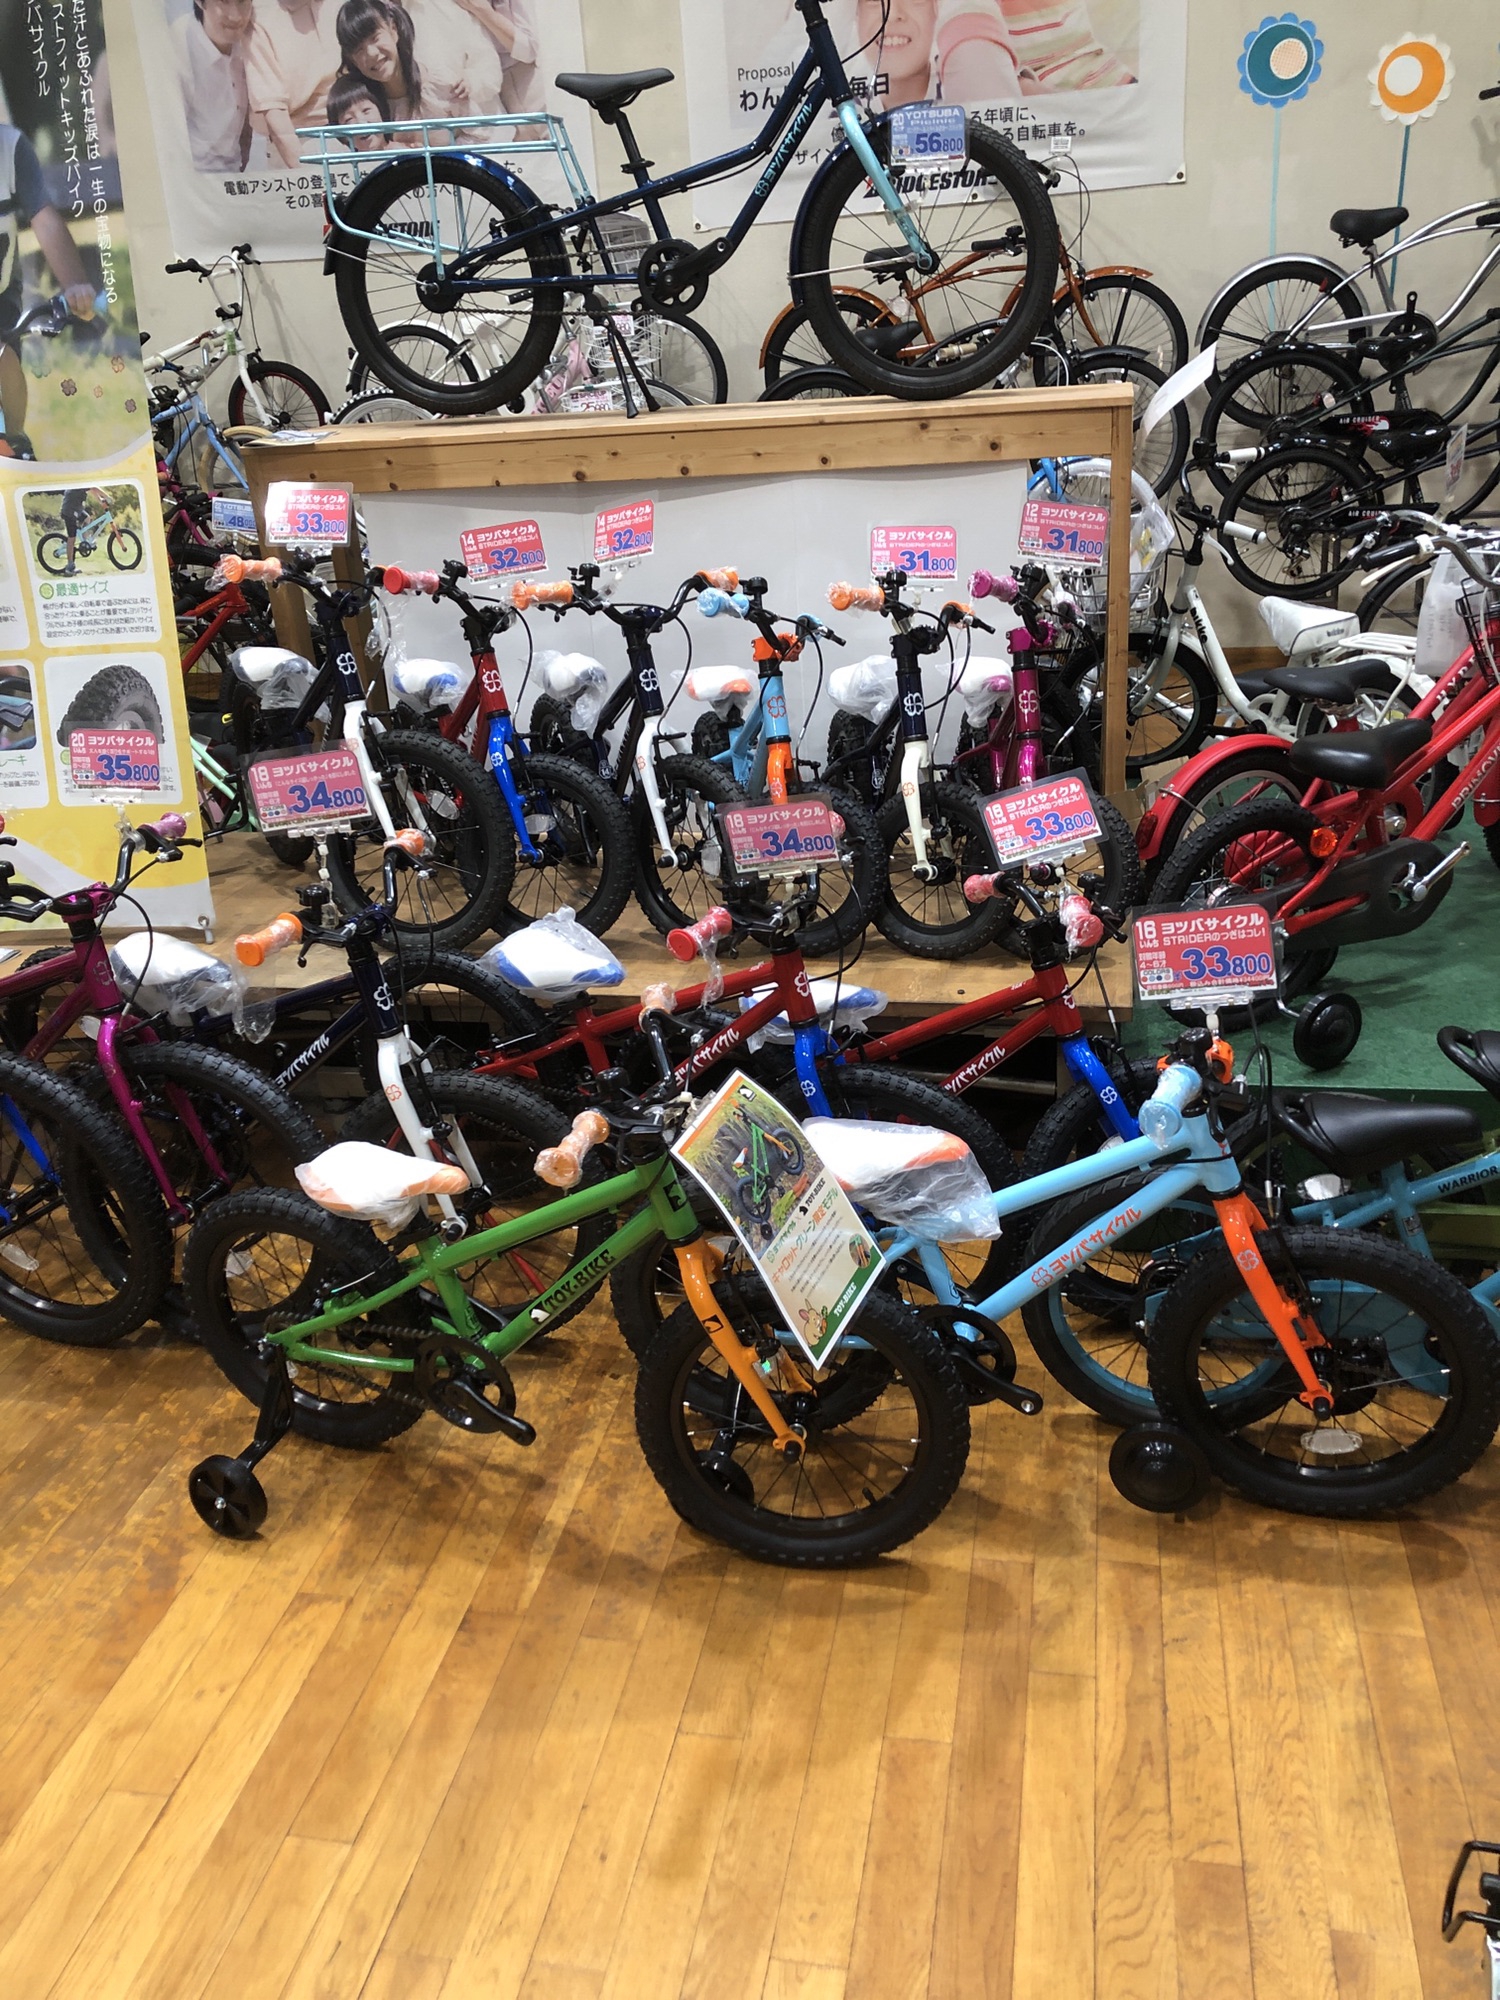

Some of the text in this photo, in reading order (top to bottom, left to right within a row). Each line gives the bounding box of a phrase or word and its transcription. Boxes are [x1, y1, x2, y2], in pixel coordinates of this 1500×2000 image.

[27, 0, 50, 97] バサイクル
[737, 61, 795, 83] Proposal
[739, 86, 790, 112] わん
[905, 108, 960, 119] YOTSUBA
[763, 102, 813, 182] ヨツバサイクル
[1040, 507, 1106, 522] ヨツバサイクル
[476, 524, 537, 543] ヨツバサイクル
[888, 530, 954, 541] ヨツバサイクル
[56, 581, 109, 597] 最適サイズ
[71, 732, 155, 747] 20 ヨツバサイクル
[251, 756, 354, 782] 18 ヨツバサイクル
[1005, 783, 1081, 812] ヨツバサイクル
[726, 806, 825, 829] 18 ヨツバサイクル
[1135, 912, 1264, 940] 16 ヨツバサイクル
[674, 1027, 740, 1087] ヨツバサイクル
[805, 1177, 826, 1208] TOY-BIKE
[1437, 1165, 1499, 1194] WARRIOR
[1049, 1206, 1143, 1276] ヨツバサイクル
[833, 1281, 858, 1318] TOY-BIKE
